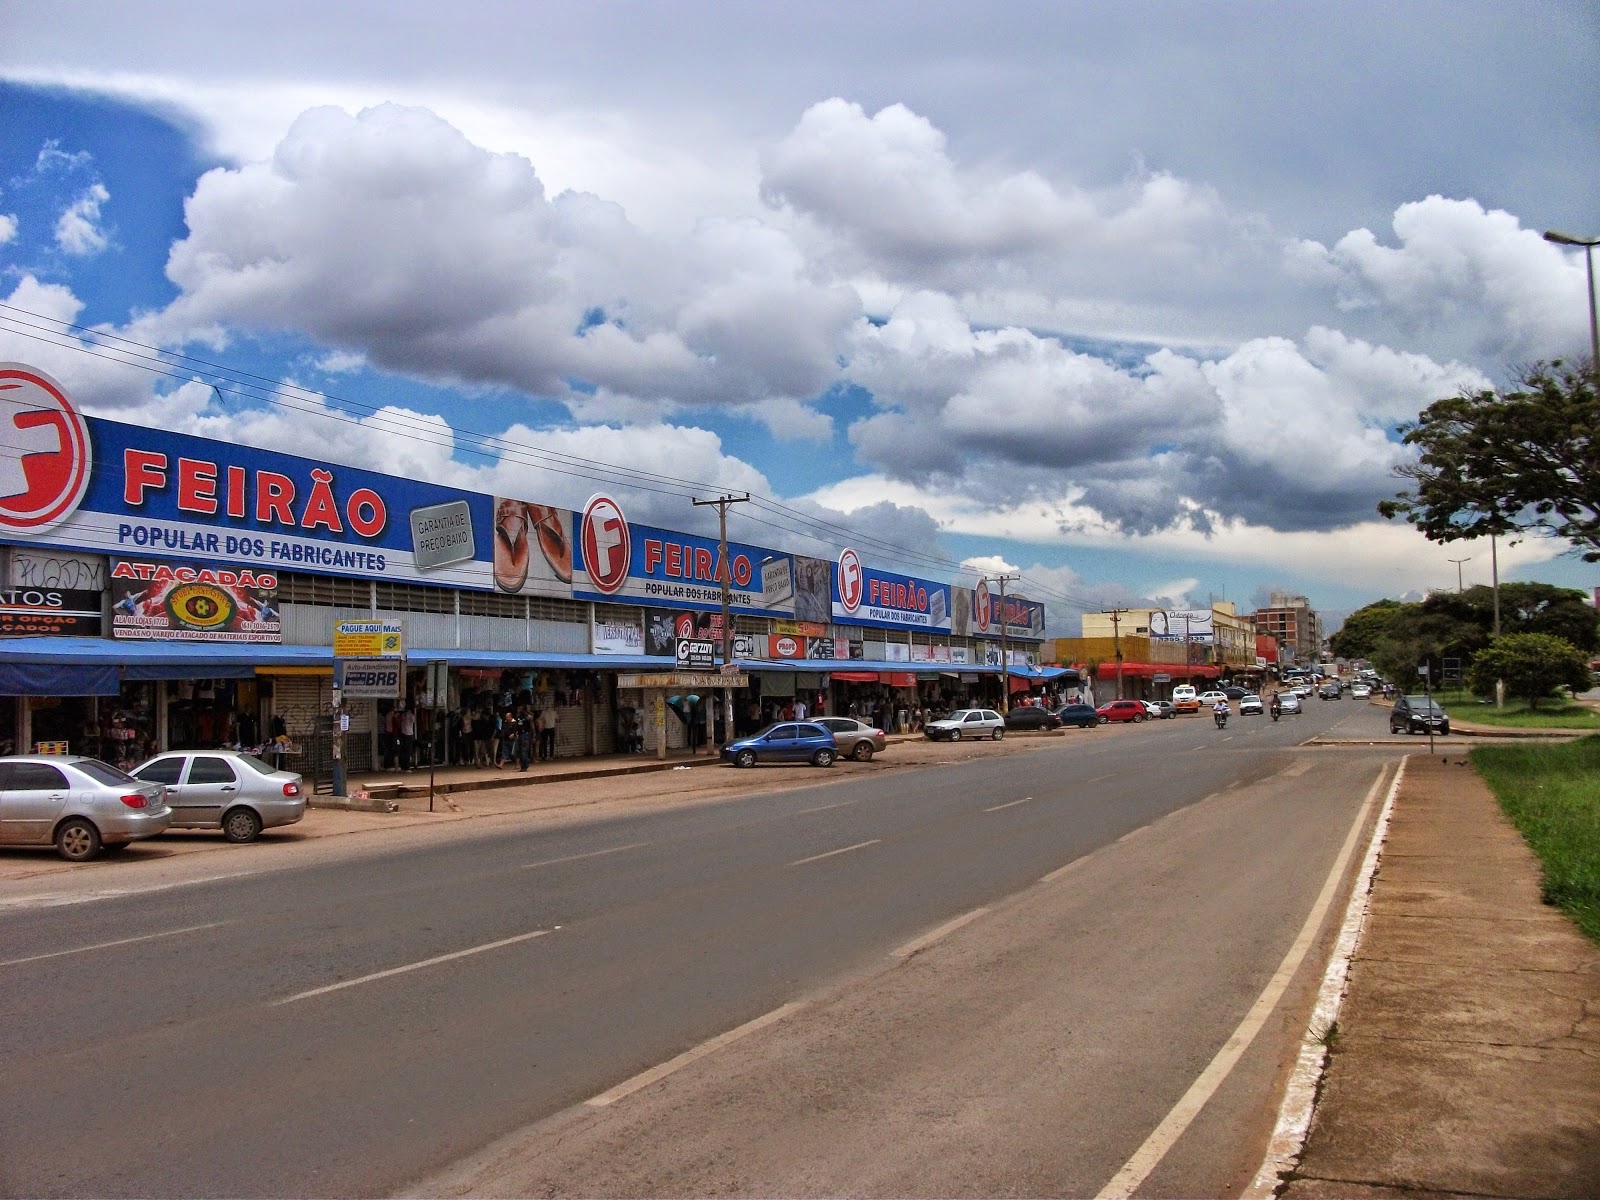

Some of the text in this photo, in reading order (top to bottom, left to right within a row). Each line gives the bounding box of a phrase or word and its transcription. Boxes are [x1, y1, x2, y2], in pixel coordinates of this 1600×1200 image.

[124, 448, 387, 538] FEIRÃO
[418, 513, 465, 534] GARANTIA DE
[118, 523, 386, 571] POPULAR DOS FABRICANTES
[420, 531, 468, 553] PREÇO BAIXO
[111, 562, 278, 590] ATACADÃO
[0, 590, 63, 607] TOS
[645, 583, 751, 605] POPULAR DOS FABRANTES
[869, 578, 928, 612] FEIRÃO
[19, 616, 77, 624] OPÇÃO
[113, 615, 127, 625] ALA
[135, 617, 151, 627] LOJAS
[869, 609, 928, 624] POPULAR DOS FABRICANTES
[0, 624, 61, 632] ÇADOS
[114, 628, 141, 638] VENDAS
[141, 629, 151, 638] NO
[153, 630, 174, 641] VAREJO
[180, 631, 209, 641] ATACADO
[209, 633, 217, 641] DE
[218, 633, 247, 642] MATERIAIS
[248, 634, 281, 643] ESPORTIVOS
[341, 624, 381, 633] PAGUE AQUI
[366, 671, 398, 686] BRB
